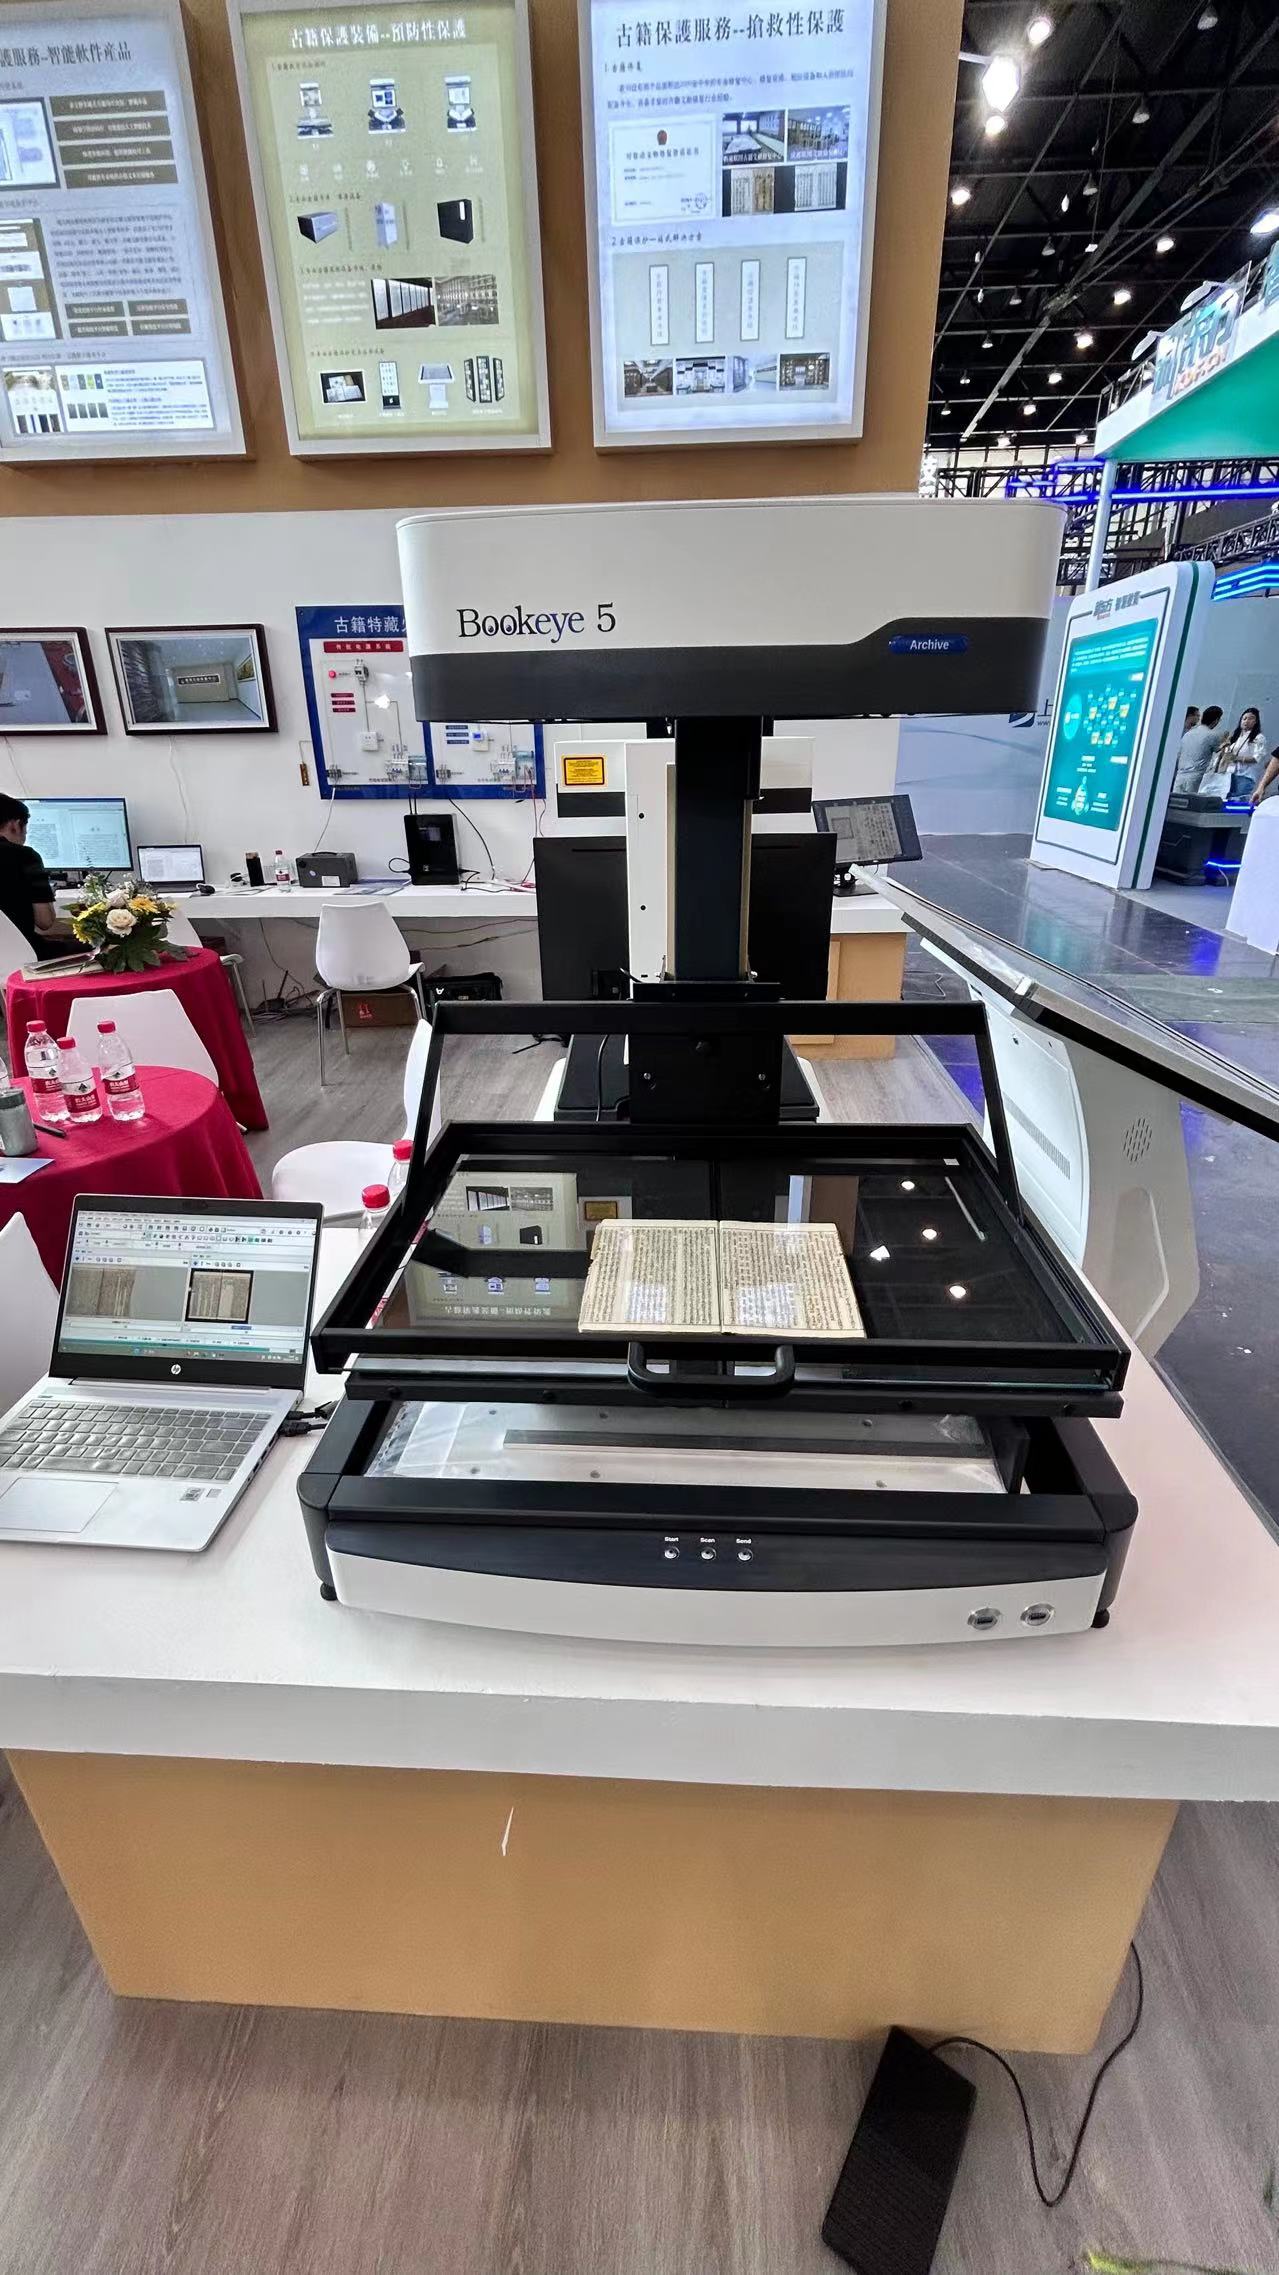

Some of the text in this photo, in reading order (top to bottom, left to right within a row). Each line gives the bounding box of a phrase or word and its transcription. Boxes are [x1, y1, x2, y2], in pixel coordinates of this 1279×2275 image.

[617, 9, 845, 48] 古籍保護服務--搶救性保護
[456, 602, 616, 643] Bookeye 5
[909, 639, 950, 650] Archive
